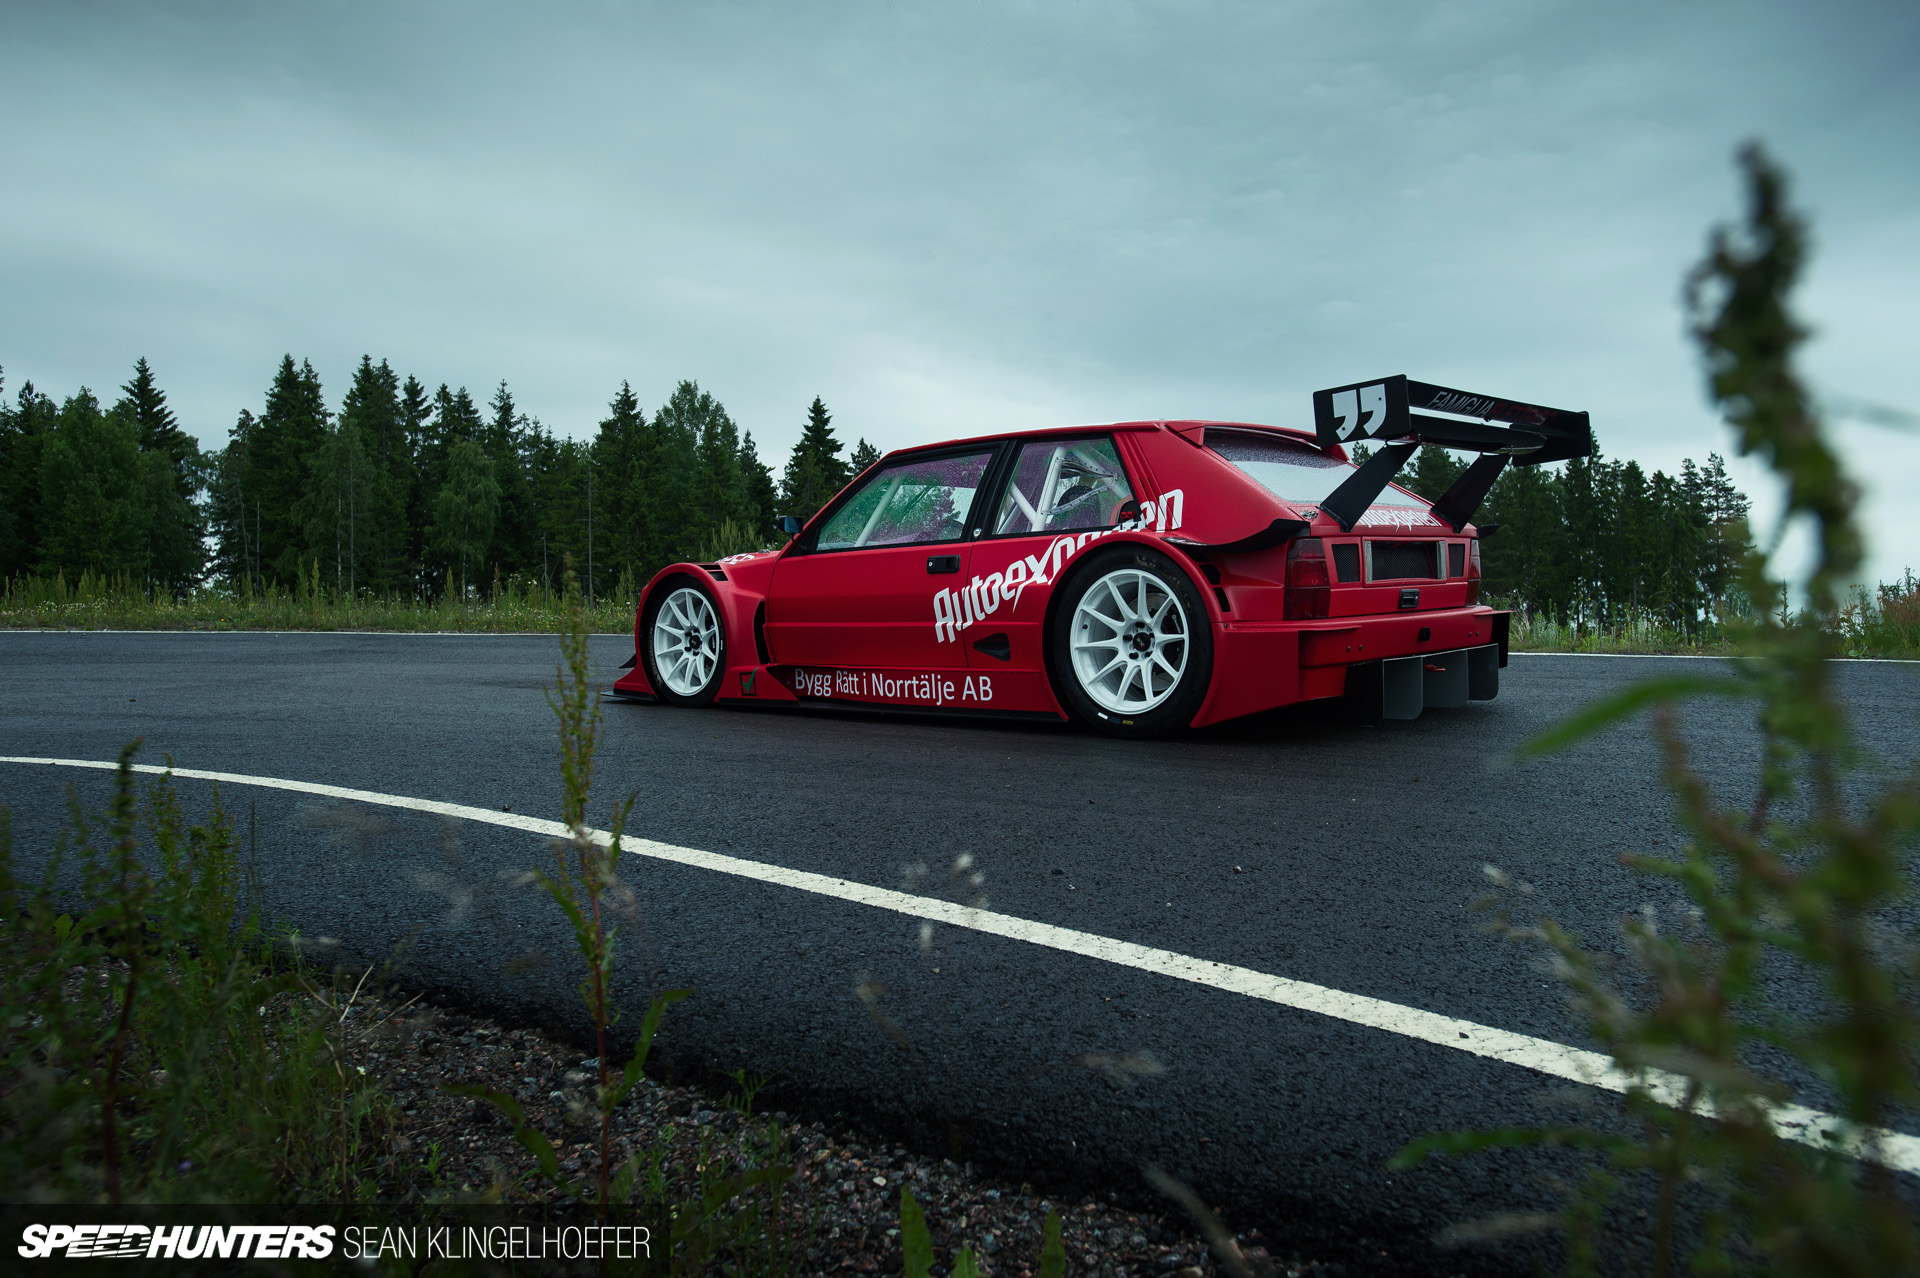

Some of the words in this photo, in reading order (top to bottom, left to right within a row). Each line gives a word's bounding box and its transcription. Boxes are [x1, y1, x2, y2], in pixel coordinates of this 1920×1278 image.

[1425, 391, 1495, 417] FAMIGLIA
[794, 668, 832, 697] Bygg
[835, 670, 860, 695] Rätt
[863, 672, 868, 695] i
[872, 673, 955, 705] Norrtälje
[961, 675, 993, 701] AB
